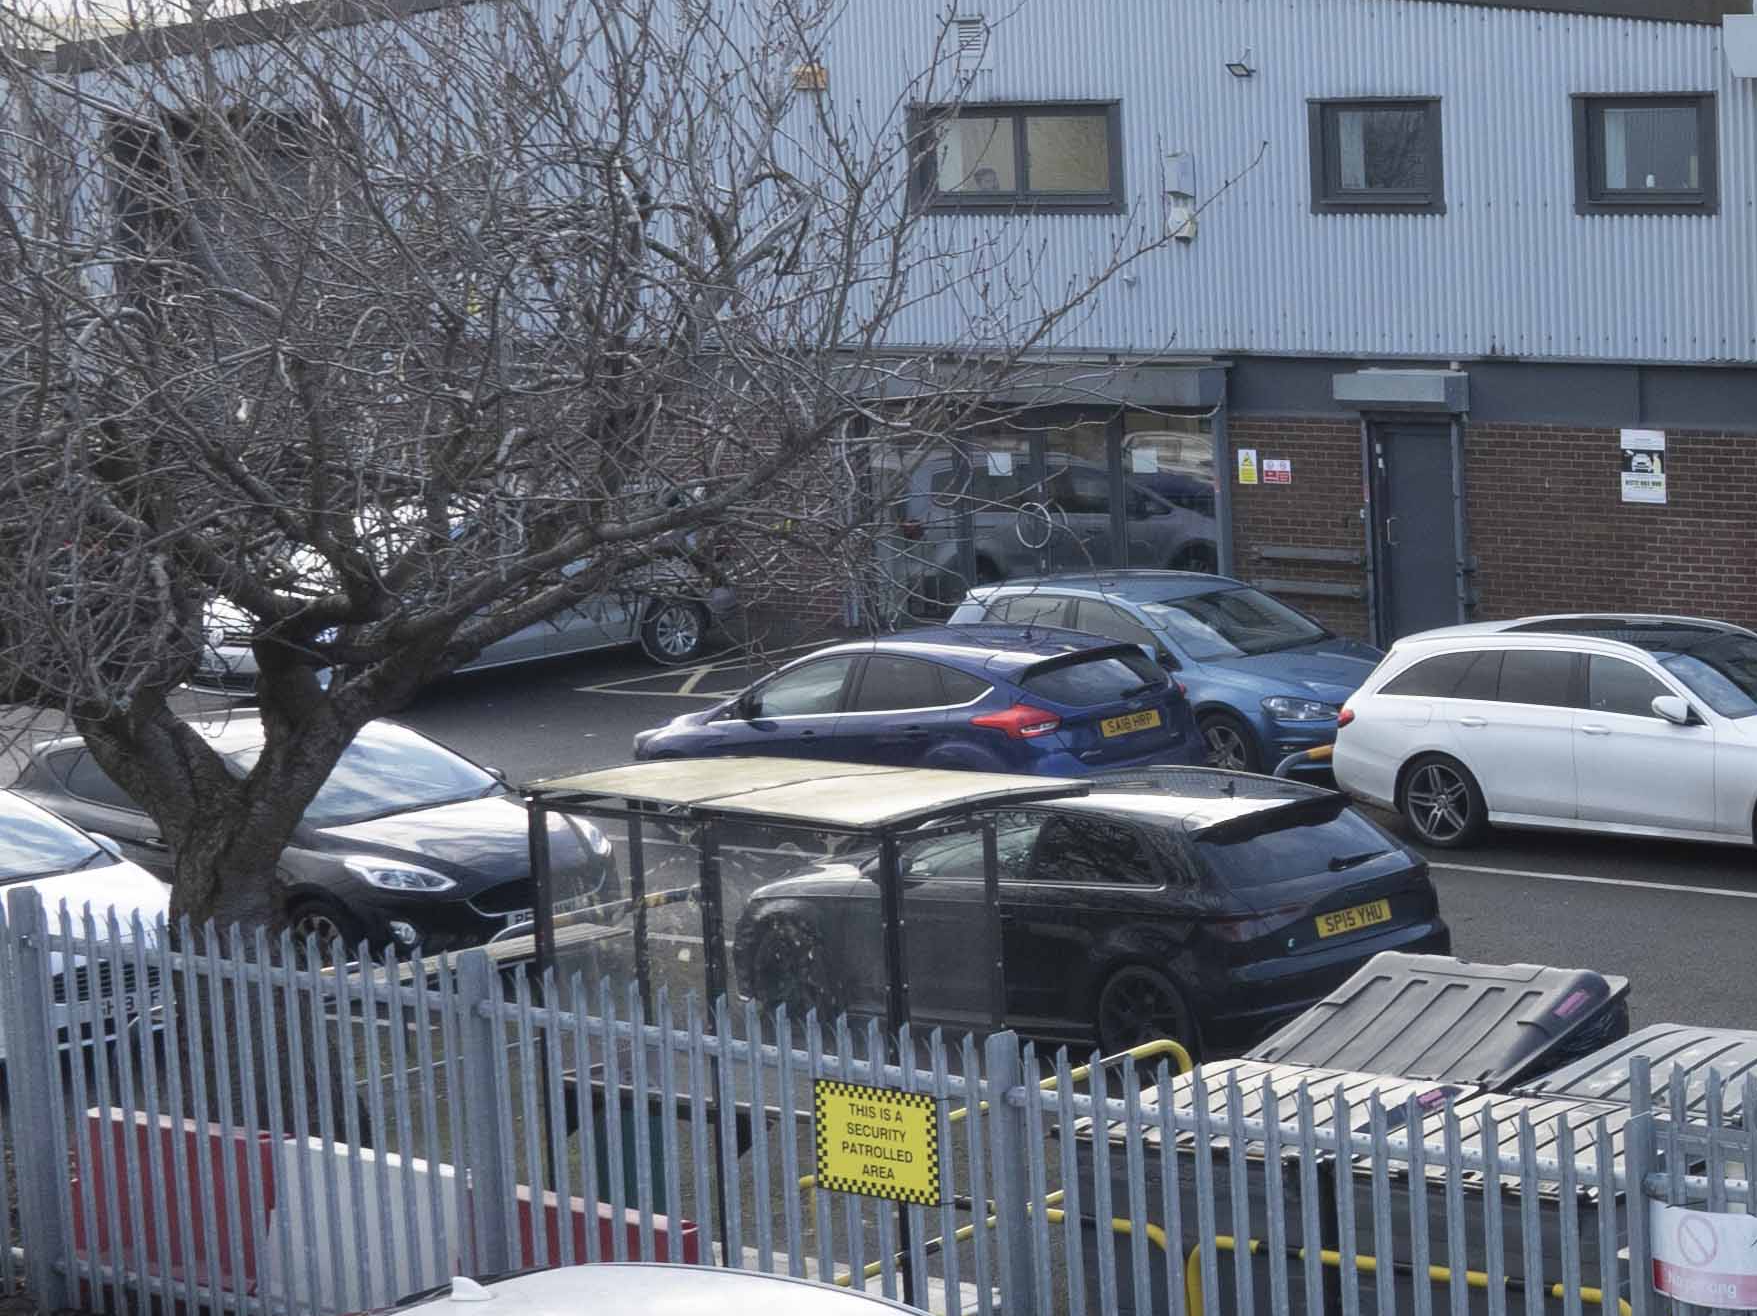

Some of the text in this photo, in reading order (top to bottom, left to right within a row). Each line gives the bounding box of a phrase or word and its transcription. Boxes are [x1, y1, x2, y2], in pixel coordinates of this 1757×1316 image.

[1325, 904, 1383, 933] SP15 YHU
[848, 1103, 903, 1123] THIS IS A
[846, 1122, 906, 1143] SECURITY
[842, 1140, 913, 1163] PATROLLED
[862, 1164, 895, 1180] AREA
